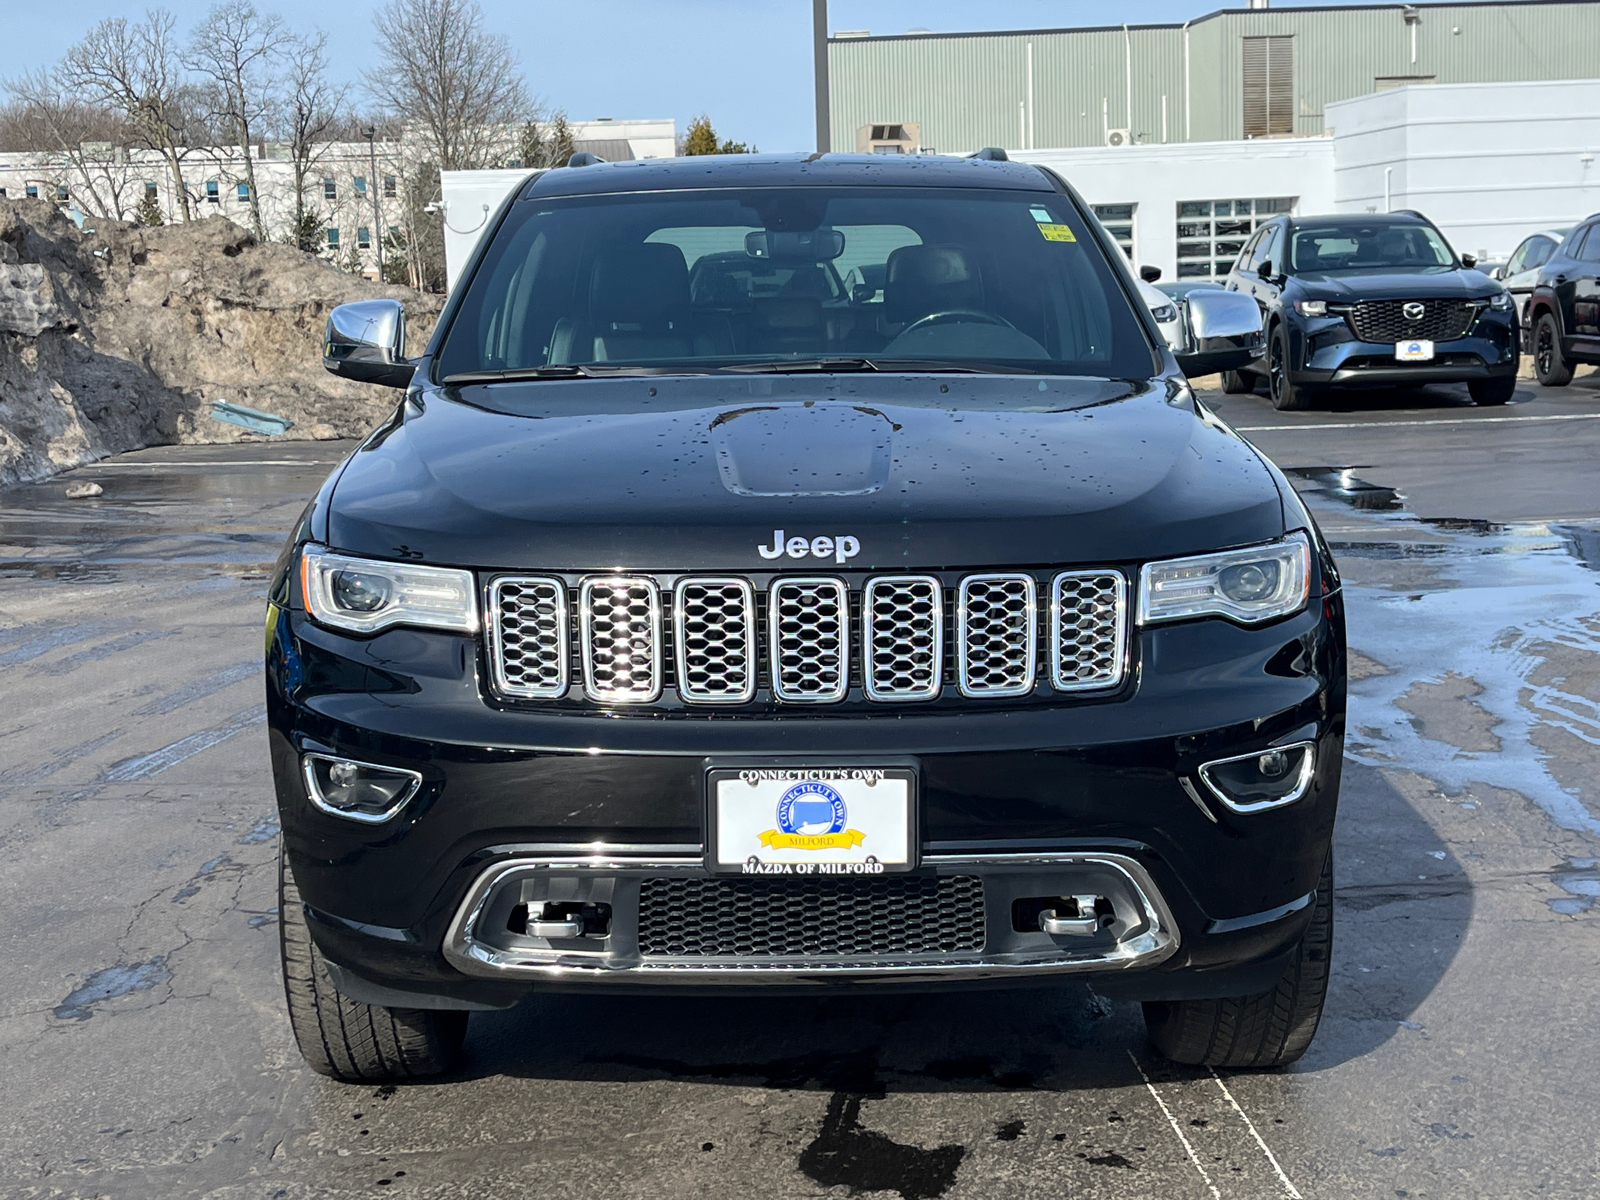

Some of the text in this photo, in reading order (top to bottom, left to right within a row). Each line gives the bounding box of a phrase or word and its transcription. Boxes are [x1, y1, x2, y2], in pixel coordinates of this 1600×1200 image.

[757, 530, 861, 564] Jeep
[738, 769, 885, 780] CONNECTICUT'S OWN
[780, 783, 844, 828] CONNECTICUT'S OWN
[789, 837, 835, 847] MILFORD
[741, 863, 884, 874] MAZDA OF MILFORD
